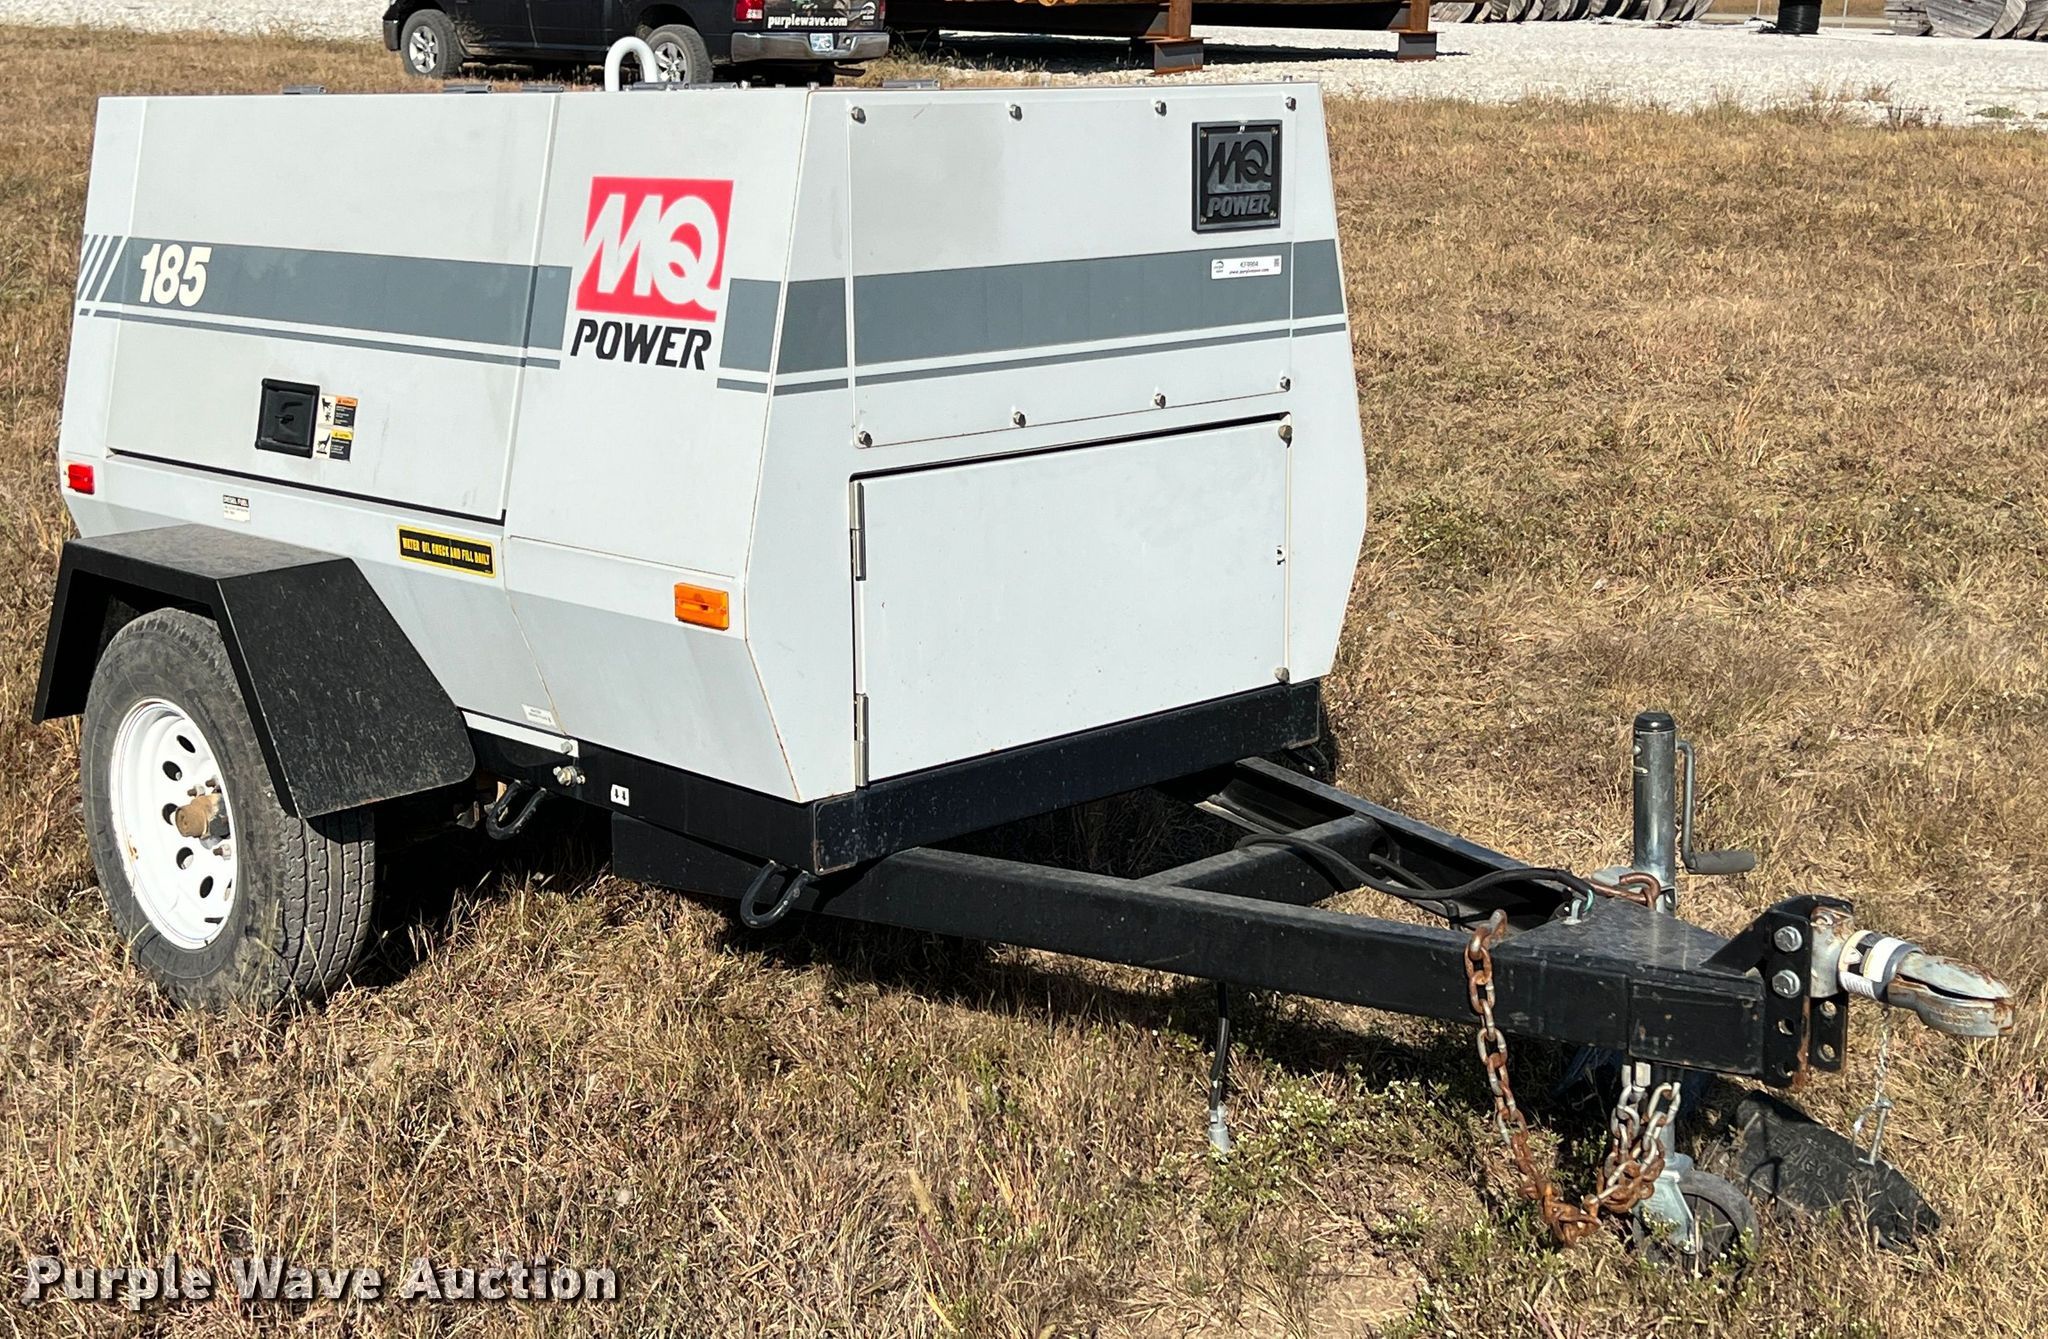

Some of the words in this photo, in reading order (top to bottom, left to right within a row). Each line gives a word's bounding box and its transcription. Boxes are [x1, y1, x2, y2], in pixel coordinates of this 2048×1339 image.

[767, 13, 848, 29] purplewave.com
[1206, 139, 1273, 185] MQ
[1206, 194, 1272, 218] POWER
[140, 243, 212, 307] 185
[576, 192, 721, 312] MQ
[570, 318, 712, 371] POWER
[421, 541, 431, 554] OIL
[431, 543, 449, 557] CHECK
[450, 547, 461, 560] AND
[461, 549, 474, 562] FILL
